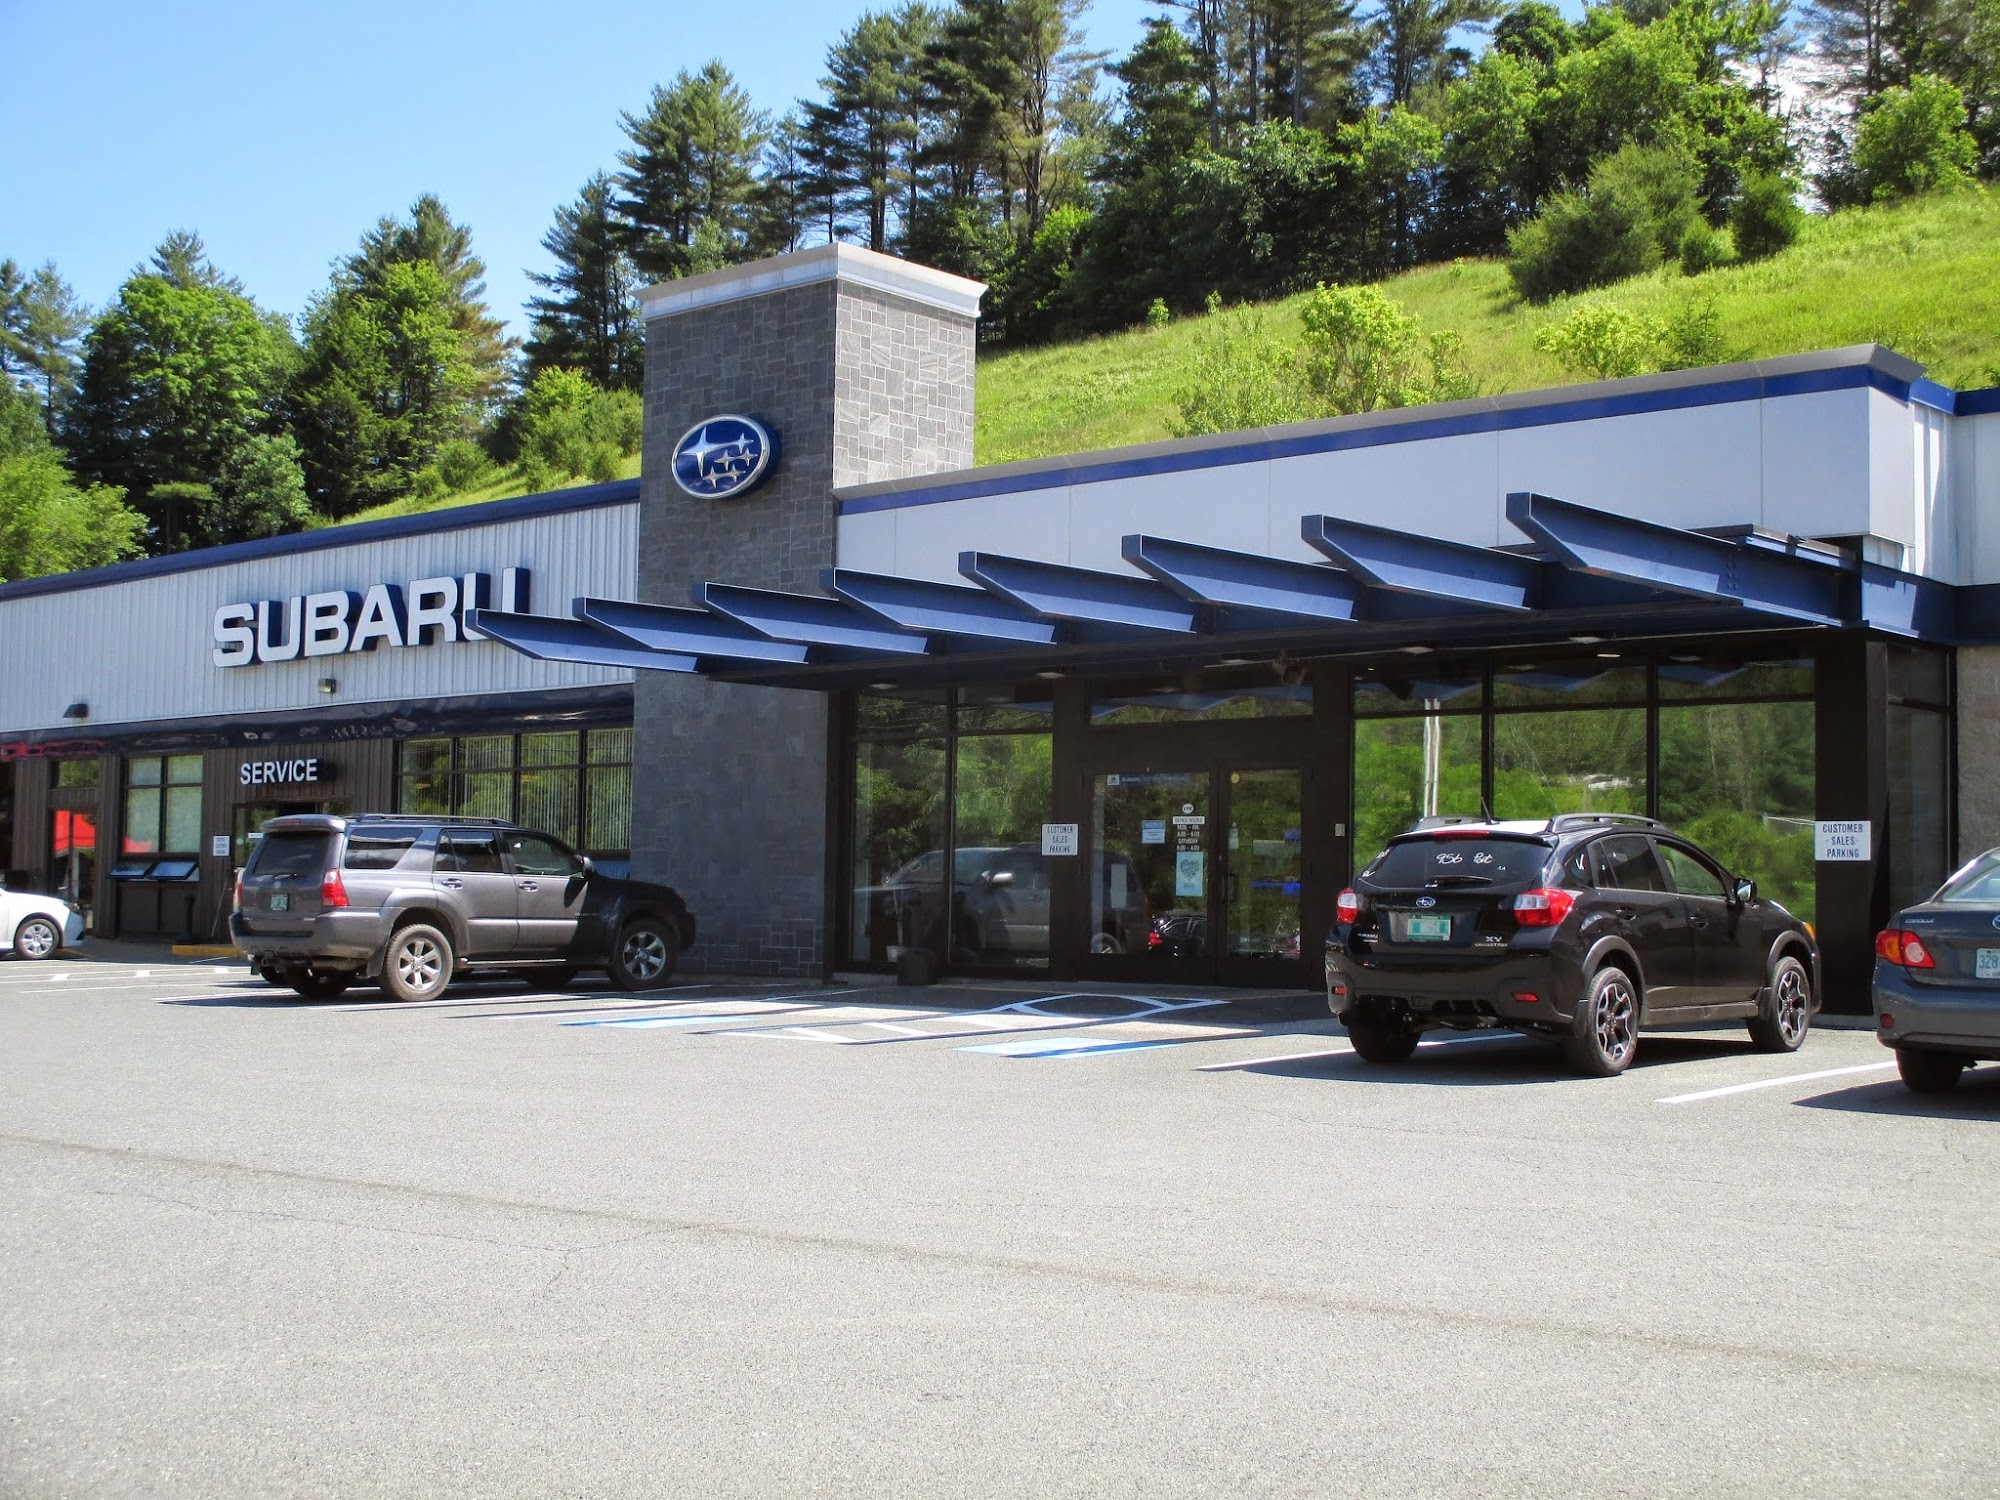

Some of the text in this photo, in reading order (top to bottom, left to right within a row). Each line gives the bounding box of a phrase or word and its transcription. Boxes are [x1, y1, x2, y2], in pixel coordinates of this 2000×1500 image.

[212, 566, 524, 668] SUBARU
[240, 758, 318, 785] SERVICE
[1047, 825, 1073, 834] CUSTOMER
[1822, 823, 1863, 833] CUSTOMER
[1052, 835, 1068, 844] SALES
[1831, 836, 1856, 846] SALES
[1049, 845, 1071, 853] PARKING
[1826, 848, 1860, 858] PARKING
[1978, 954, 1999, 969] 328
